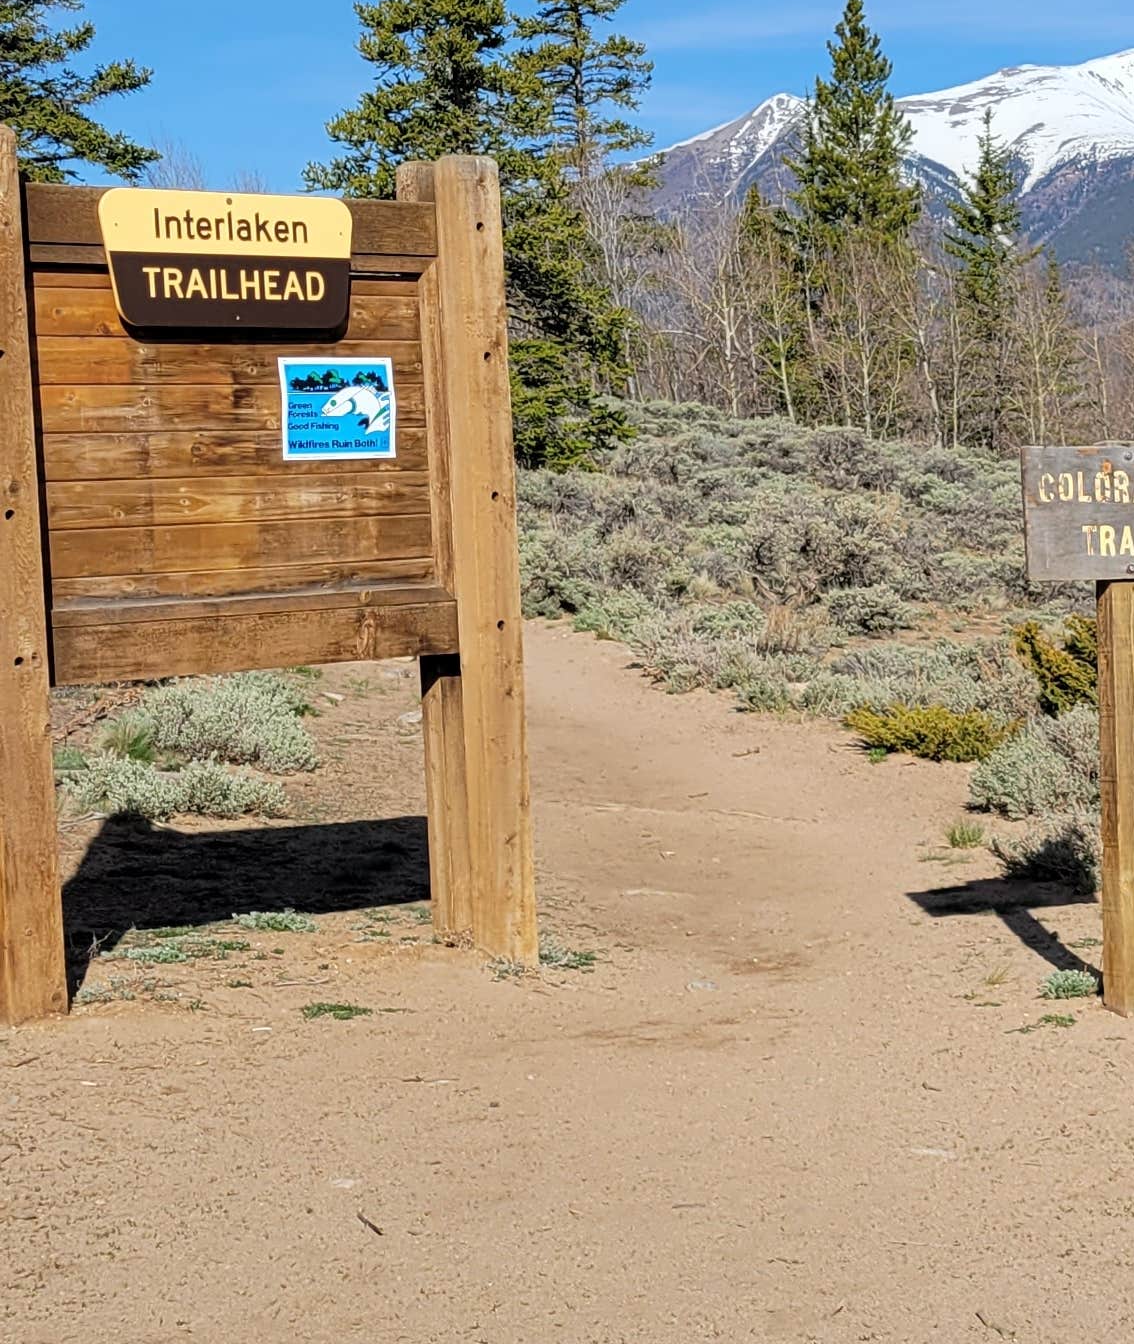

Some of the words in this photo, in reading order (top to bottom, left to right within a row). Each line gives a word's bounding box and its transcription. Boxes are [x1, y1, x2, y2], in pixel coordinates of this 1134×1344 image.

[154, 207, 308, 243] Interlaken
[142, 267, 326, 301] TRAILHEAD
[288, 422, 309, 430] Good
[310, 422, 339, 431] Fishing
[288, 440, 330, 449] Wildfires
[332, 439, 353, 448] Ruin
[354, 439, 378, 448] Both!
